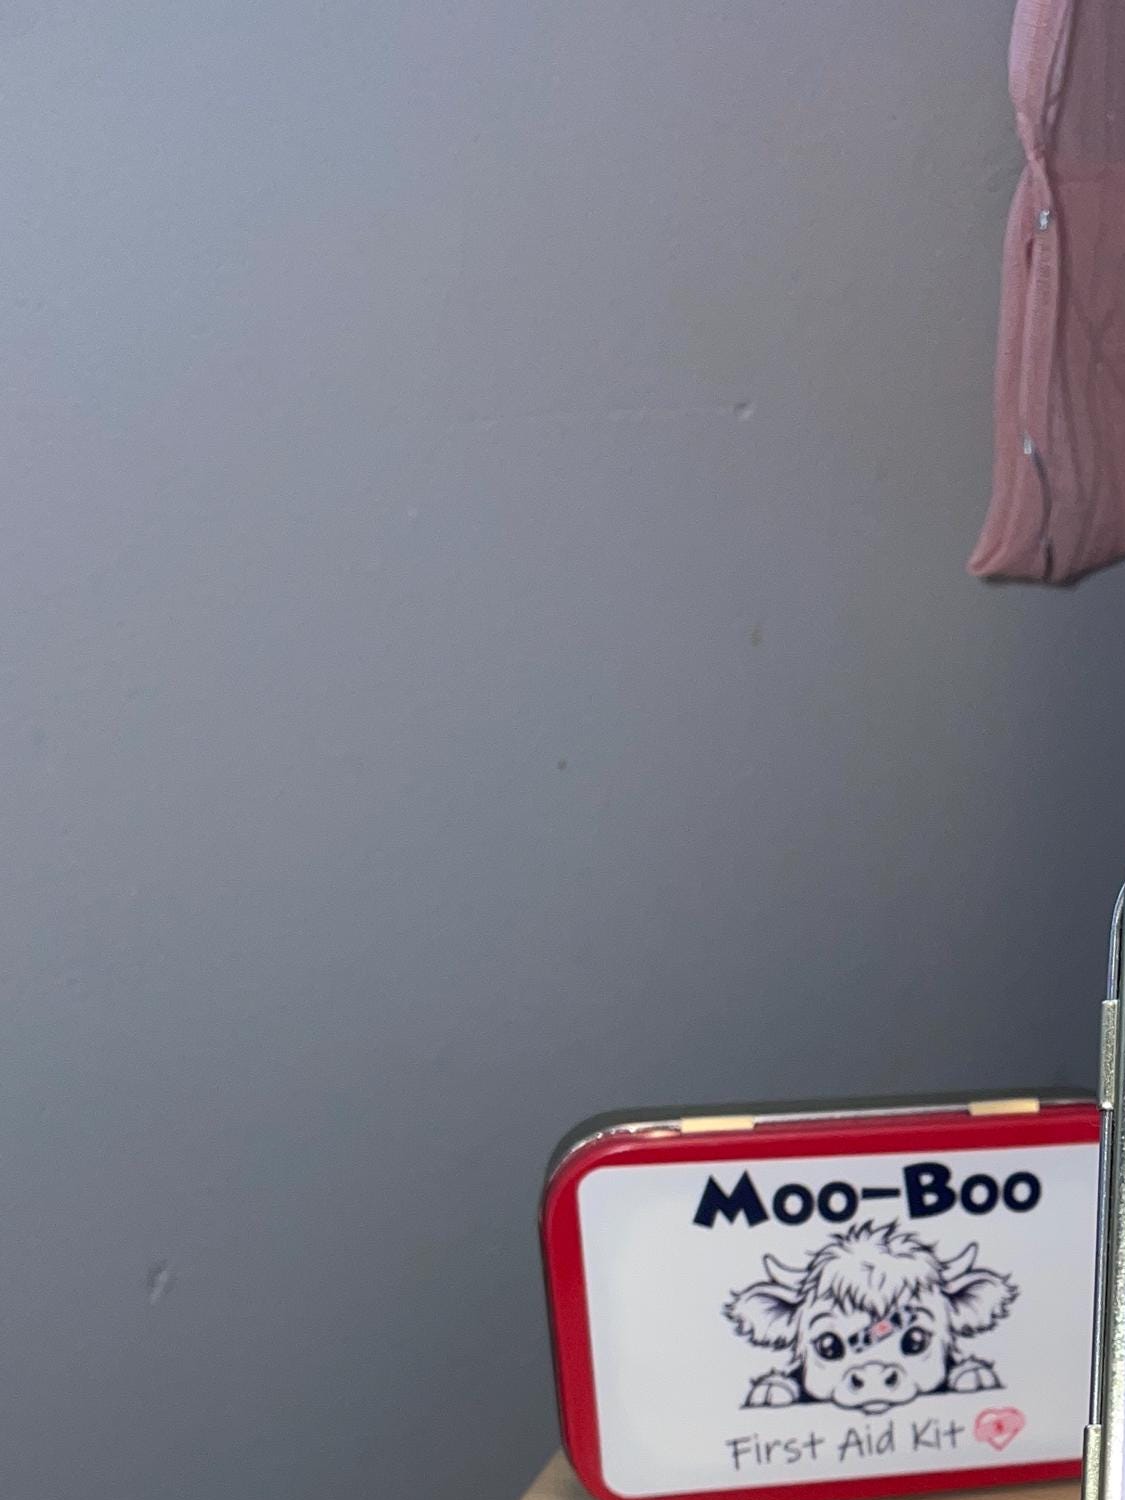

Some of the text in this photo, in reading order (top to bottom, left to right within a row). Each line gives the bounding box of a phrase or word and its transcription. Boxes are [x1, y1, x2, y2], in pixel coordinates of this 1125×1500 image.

[725, 1418, 965, 1470] First Aid Kit
